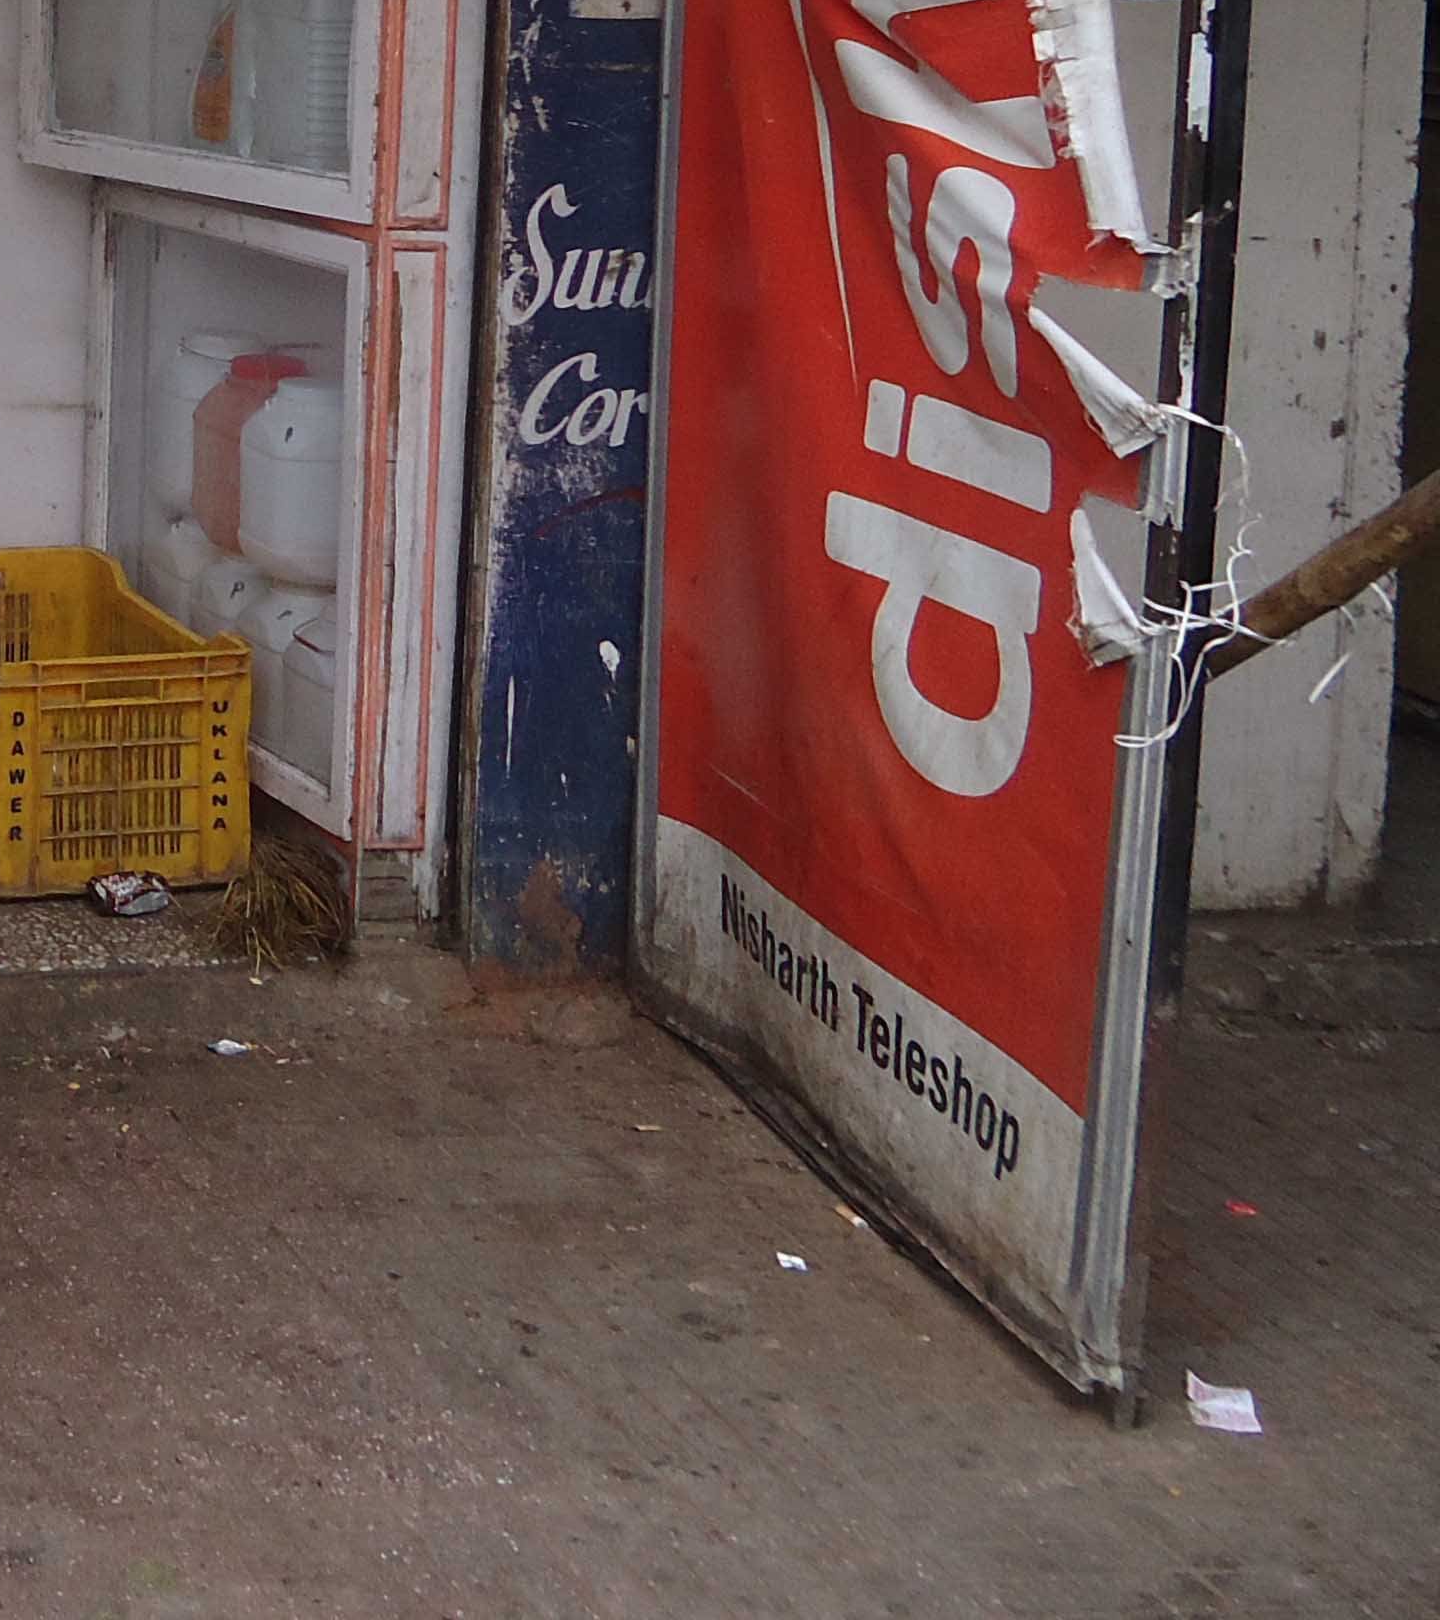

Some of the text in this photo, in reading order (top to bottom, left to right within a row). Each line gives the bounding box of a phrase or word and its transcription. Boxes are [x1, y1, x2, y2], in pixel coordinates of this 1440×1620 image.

[8, 710, 27, 843] DAWER
[210, 700, 230, 831] UKLANA
[720, 873, 1021, 1181] Nisharth Teleshop
